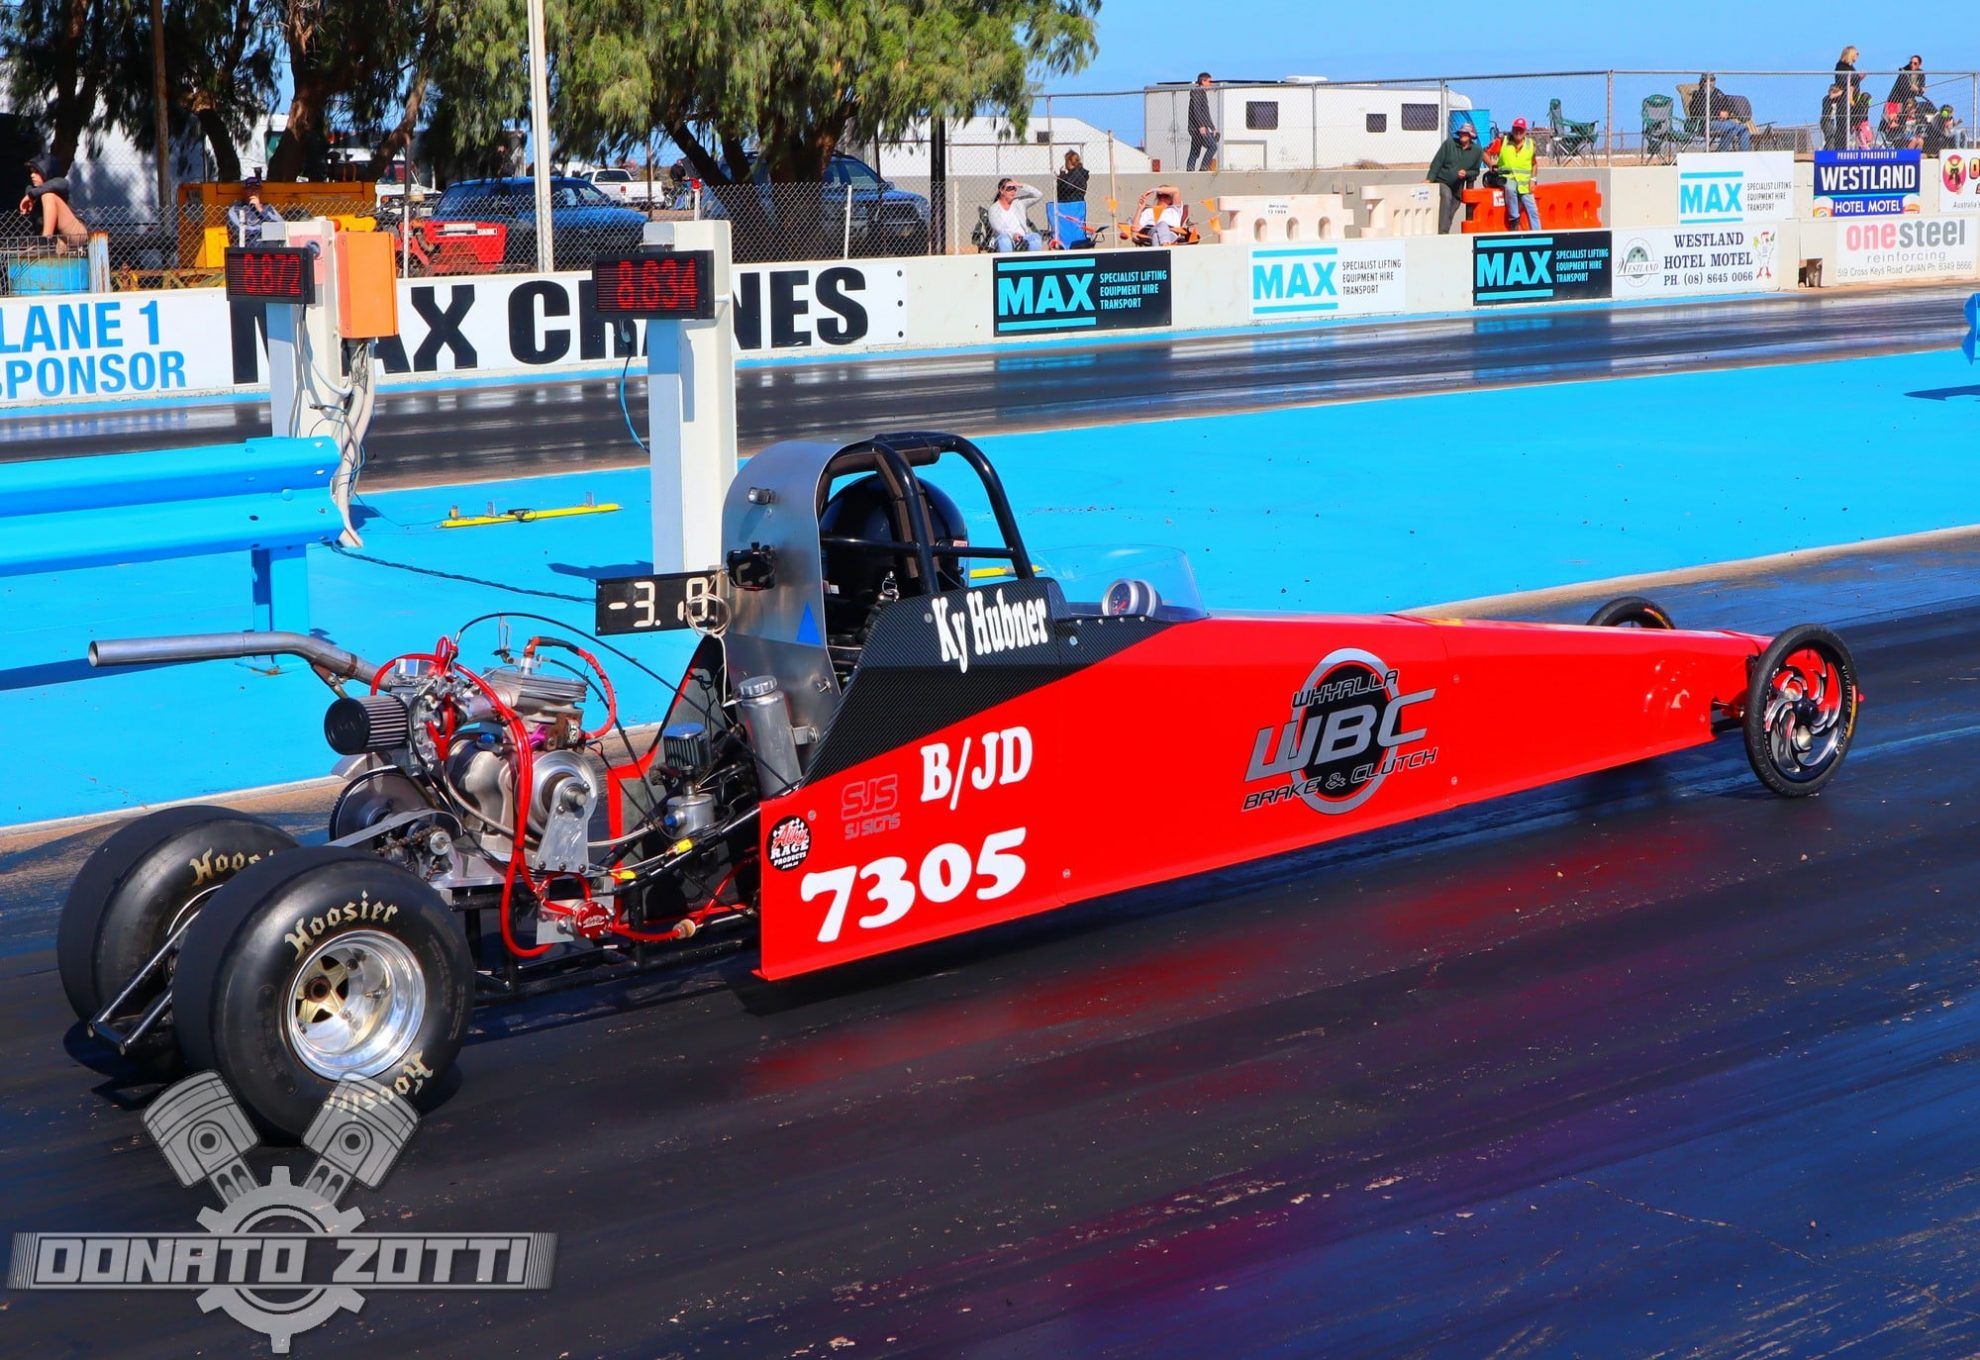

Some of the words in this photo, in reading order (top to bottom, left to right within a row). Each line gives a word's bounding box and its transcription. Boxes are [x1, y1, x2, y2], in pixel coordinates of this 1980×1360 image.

[1969, 157, 1980, 180] O
[1747, 182, 1773, 190] SPECIALIST
[1774, 181, 1792, 190] LIFTING
[1820, 165, 1916, 191] WESTLAND
[1680, 183, 1742, 214] MAX
[1747, 192, 1774, 201] EQUIPMENT
[1775, 191, 1786, 200] HIRE
[1747, 203, 1774, 211] TRANSPORT
[1835, 201, 1865, 214] HOTEL
[1868, 200, 1901, 213] MOTEL
[1673, 232, 1744, 248] WESTLAND
[1556, 249, 1587, 260] SPECIALIST
[1588, 248, 1609, 258] LIFTING
[1664, 255, 1706, 270] HOTEL
[1711, 252, 1753, 267] MOTEL
[1867, 251, 1946, 264] reinforcing
[1342, 260, 1376, 271] SPECIALIST
[1378, 259, 1402, 269] LIFTING
[1476, 250, 1553, 288] MAX
[1556, 261, 1588, 272] EQUIPMENT
[1589, 260, 1602, 270] HIRE
[1850, 267, 1868, 277] Cross
[1870, 266, 1885, 276] Keys
[1886, 265, 1903, 274] Road
[1905, 263, 1926, 273] CAVAN
[617, 258, 698, 310] 8.634
[1100, 271, 1139, 283] SPECIALIST
[1140, 270, 1167, 282] LIFTING
[1252, 262, 1338, 300] MAX
[1342, 273, 1378, 284] EQUIPMENT
[1379, 271, 1394, 281] HIRE
[1556, 272, 1589, 283] TRANSPORT
[1684, 273, 1703, 286] (08)
[1707, 272, 1728, 284] 8645
[1731, 271, 1753, 282] 0066
[998, 273, 1096, 316] MAX
[1100, 285, 1141, 297] EQUIPMENT
[1142, 283, 1159, 295] HIRE
[1342, 285, 1379, 296] TRANSPORT
[1100, 297, 1142, 310] TRANSPORT
[0, 301, 124, 353] LANE
[139, 300, 160, 346] 1
[0, 350, 186, 400] PONSOR
[932, 596, 968, 674] Ky
[966, 588, 1048, 656] Hubner
[1292, 668, 1400, 708] WHYALLA
[1244, 688, 1437, 783] WBC
[920, 726, 1033, 811] B/JD
[1241, 776, 1323, 813] BRAKE
[1325, 772, 1346, 790] &
[1350, 747, 1439, 784] CLUTCH
[841, 773, 898, 821] SJS
[845, 821, 860, 840] SJ
[770, 837, 809, 860] RACE
[774, 851, 807, 867] PRODUCTS
[800, 826, 1027, 943] 7305
[284, 890, 399, 960] Hoosier
